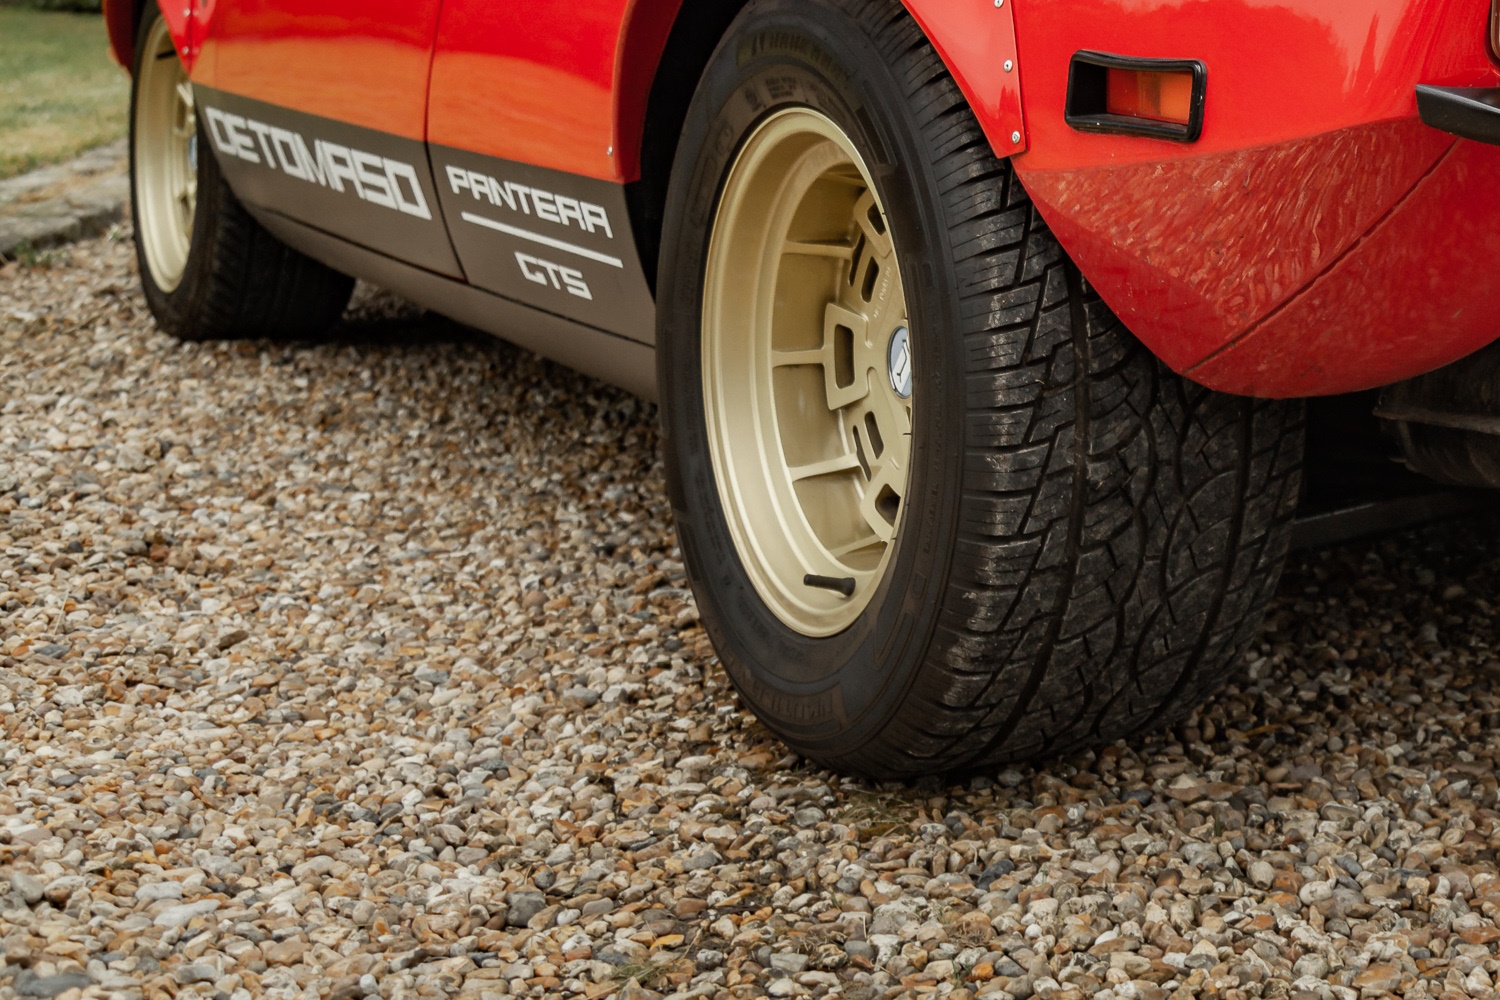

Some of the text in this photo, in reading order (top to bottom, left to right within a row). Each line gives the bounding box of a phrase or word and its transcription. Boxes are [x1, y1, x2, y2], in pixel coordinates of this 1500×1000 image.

[204, 106, 432, 221] DETOMASO
[444, 164, 614, 239] PANTERA
[513, 250, 594, 301] GTS
